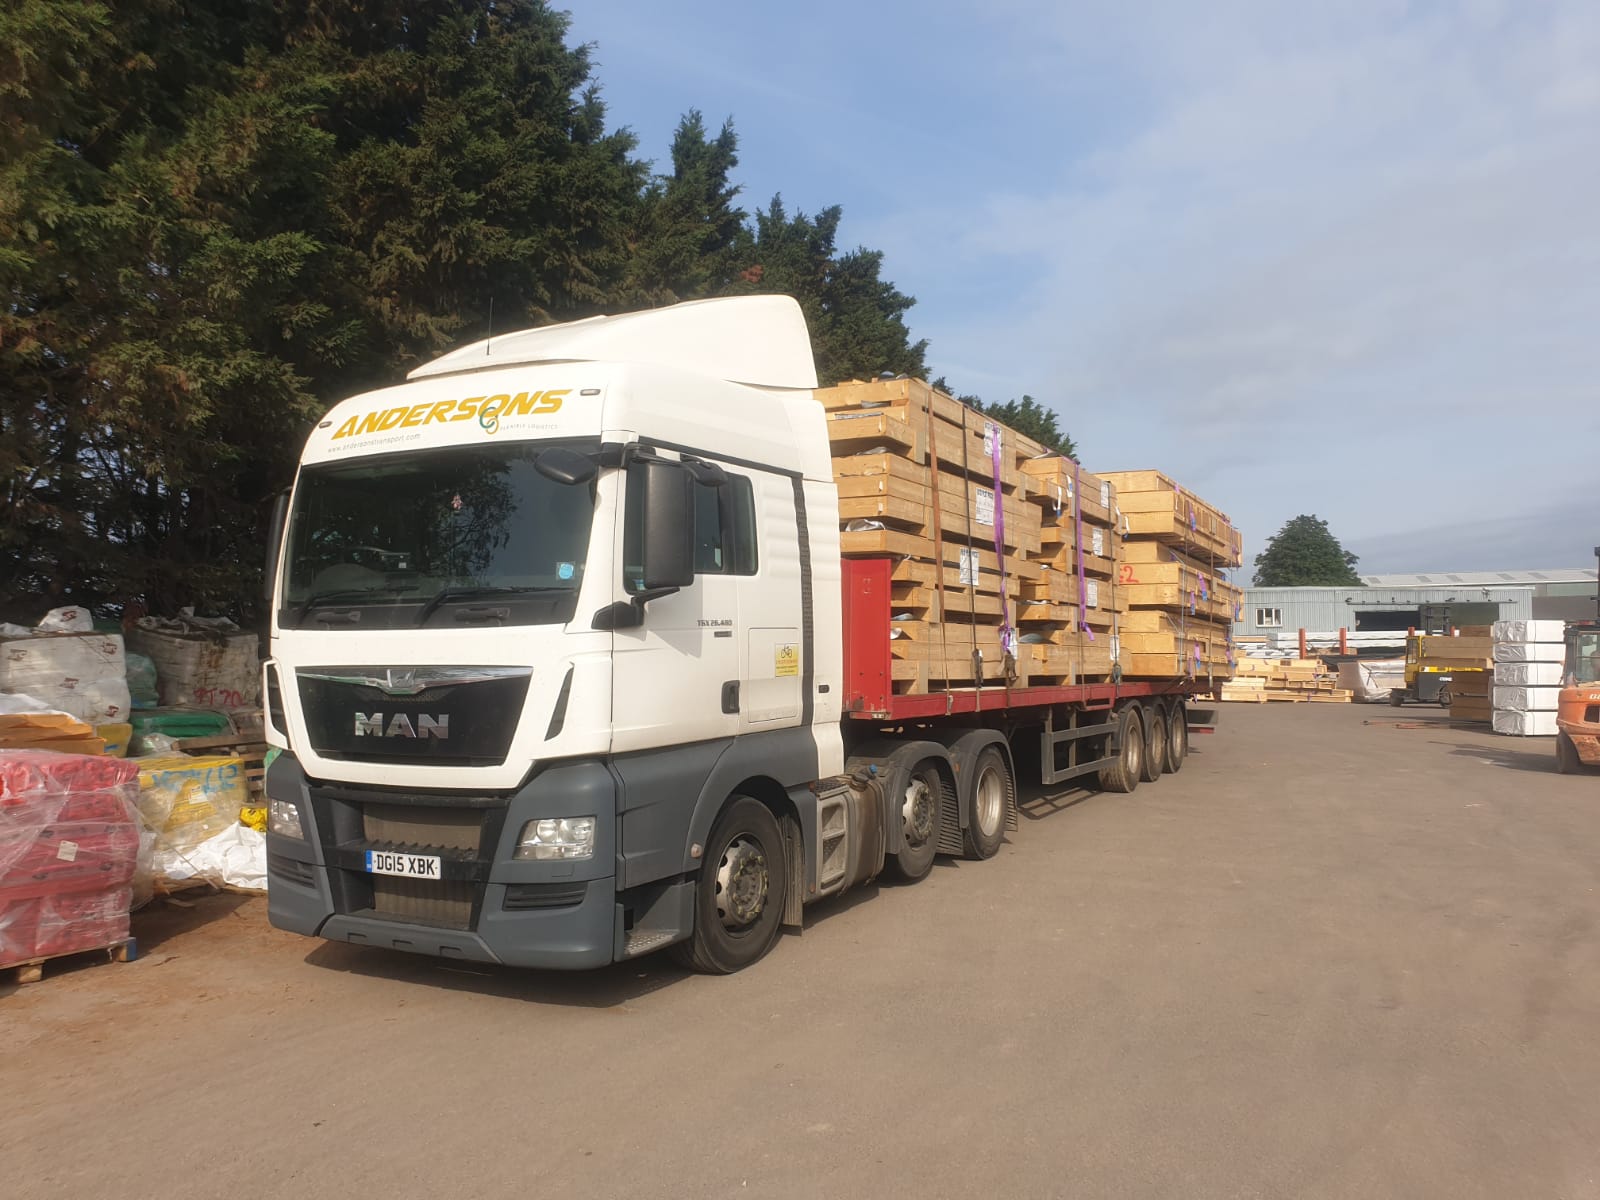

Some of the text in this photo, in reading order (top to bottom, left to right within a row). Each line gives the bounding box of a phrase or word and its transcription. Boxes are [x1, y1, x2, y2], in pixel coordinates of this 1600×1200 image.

[331, 389, 573, 440] ANDERSONS
[355, 712, 449, 738] MAN
[376, 854, 435, 876] DG15 XBK
